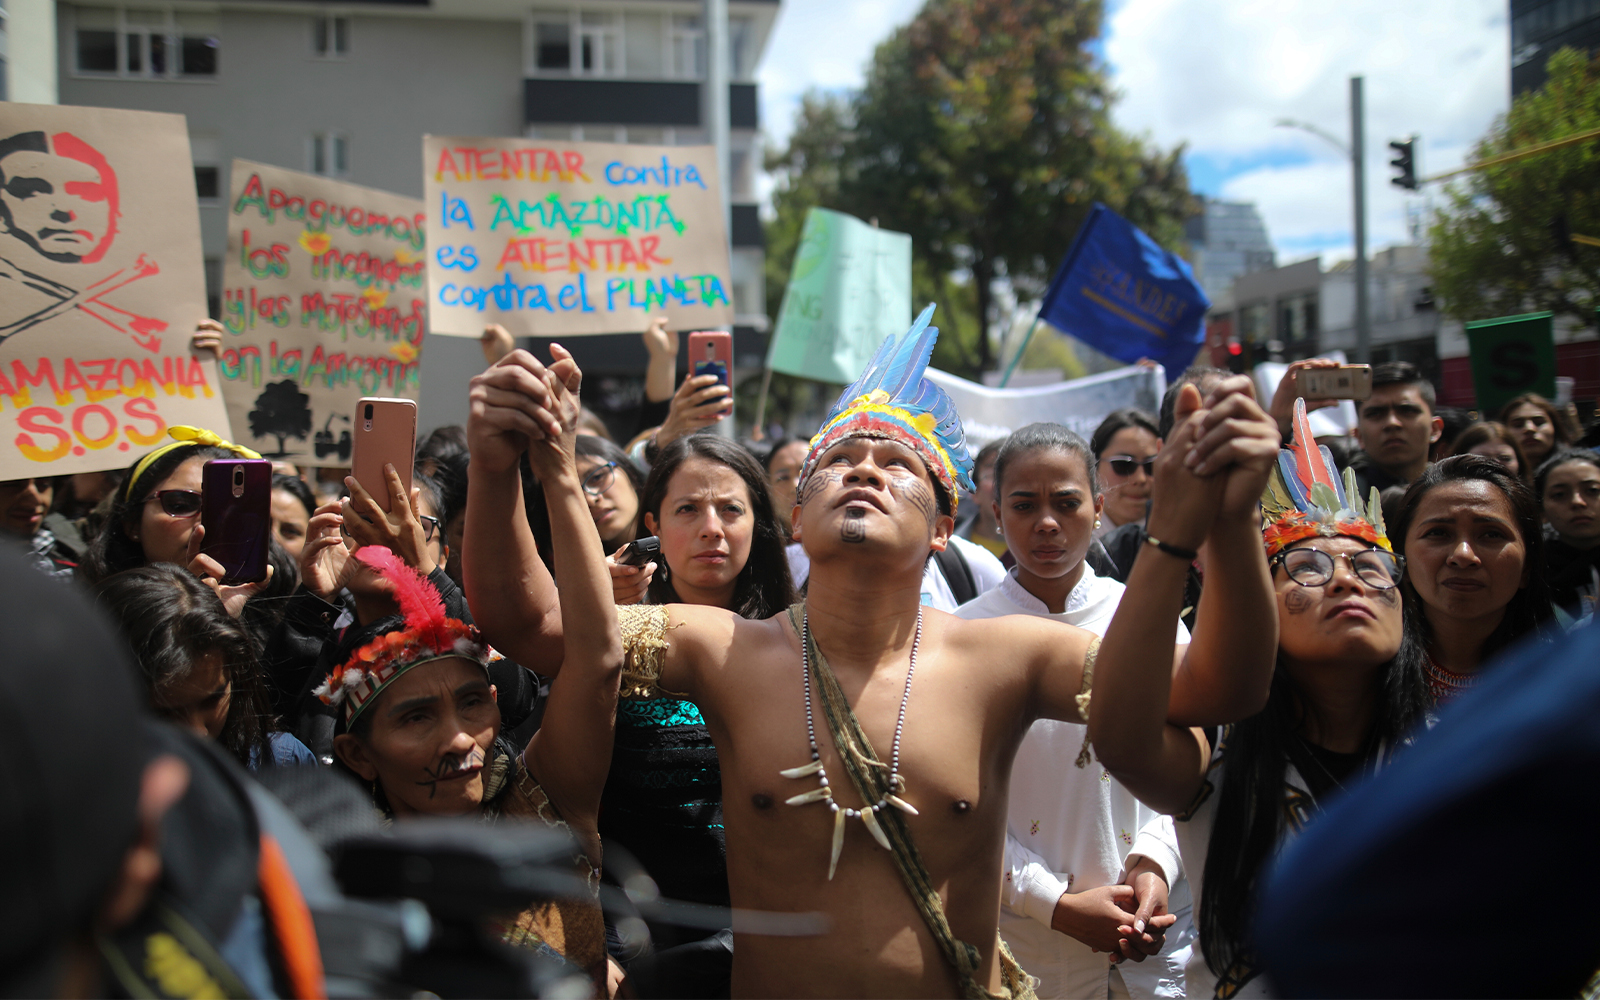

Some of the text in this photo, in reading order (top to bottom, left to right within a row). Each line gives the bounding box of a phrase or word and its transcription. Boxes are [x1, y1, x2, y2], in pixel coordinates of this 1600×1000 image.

[434, 147, 593, 183] ATENTAR
[234, 175, 426, 250] Apaguemos
[441, 191, 475, 231] la
[241, 229, 290, 279] los
[435, 235, 673, 274] es ATENTAR
[250, 287, 291, 329] las
[558, 272, 595, 313] el
[606, 274, 731, 313] PLANETA
[0, 356, 214, 412] AMAZONIA
[221, 346, 262, 388] en
[270, 341, 302, 379] la
[1489, 341, 1539, 391] S
